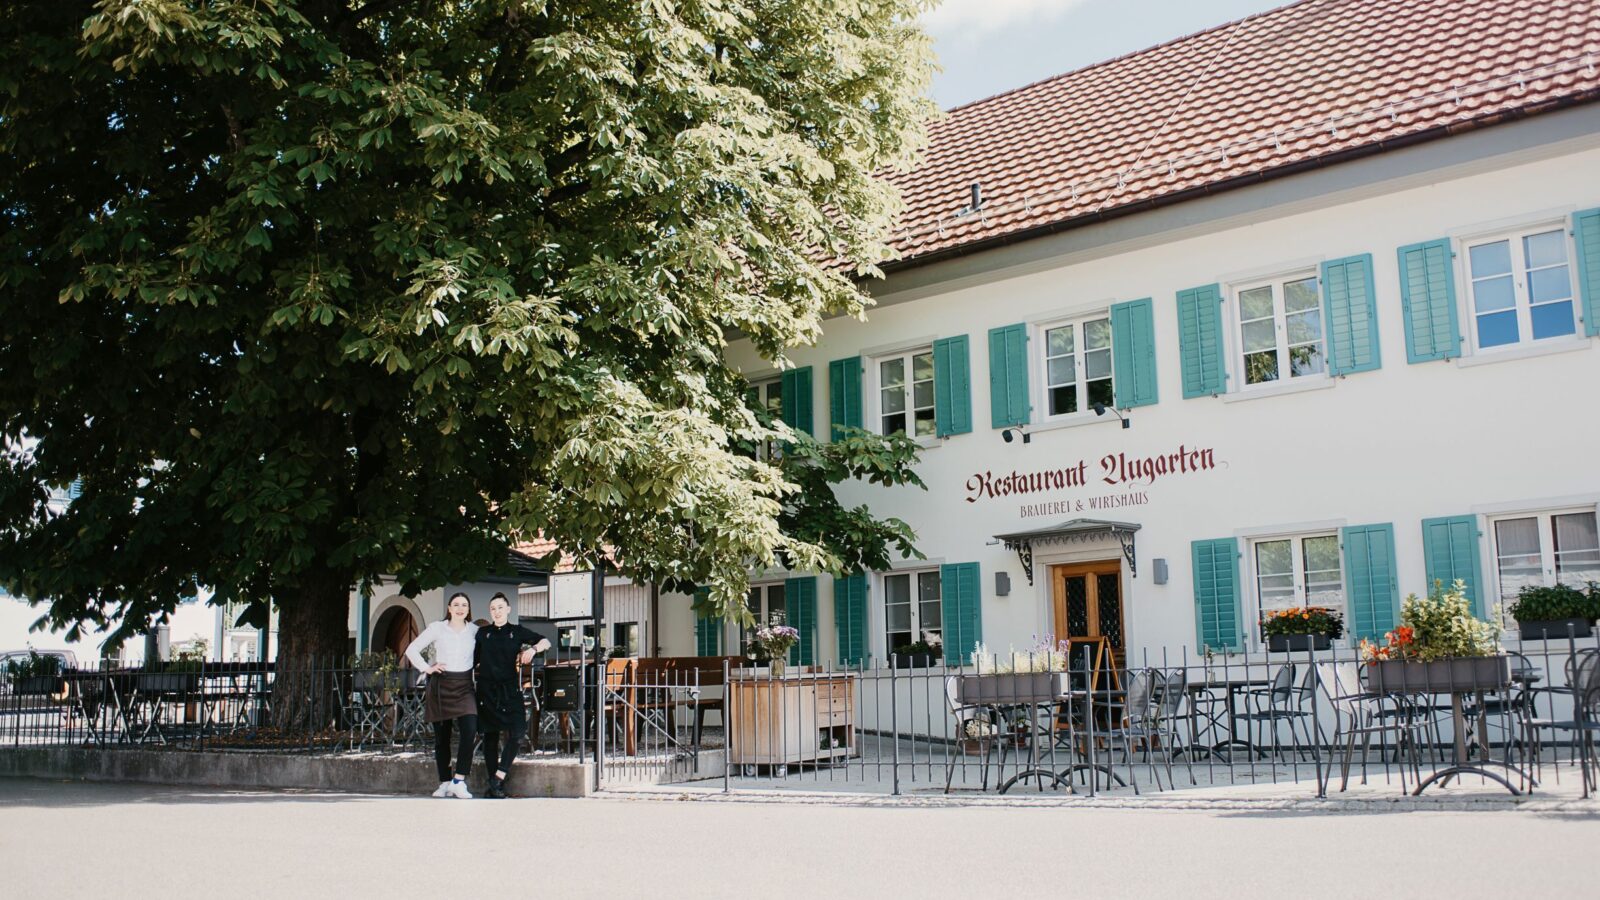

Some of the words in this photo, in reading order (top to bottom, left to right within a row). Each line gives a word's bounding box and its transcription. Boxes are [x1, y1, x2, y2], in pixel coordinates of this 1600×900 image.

[966, 460, 1088, 503] Restaurant
[1100, 444, 1220, 488] Augarten
[1020, 501, 1070, 518] BRAUEREI
[1075, 499, 1084, 512] &
[1089, 491, 1149, 510] WIRTSHAUS
